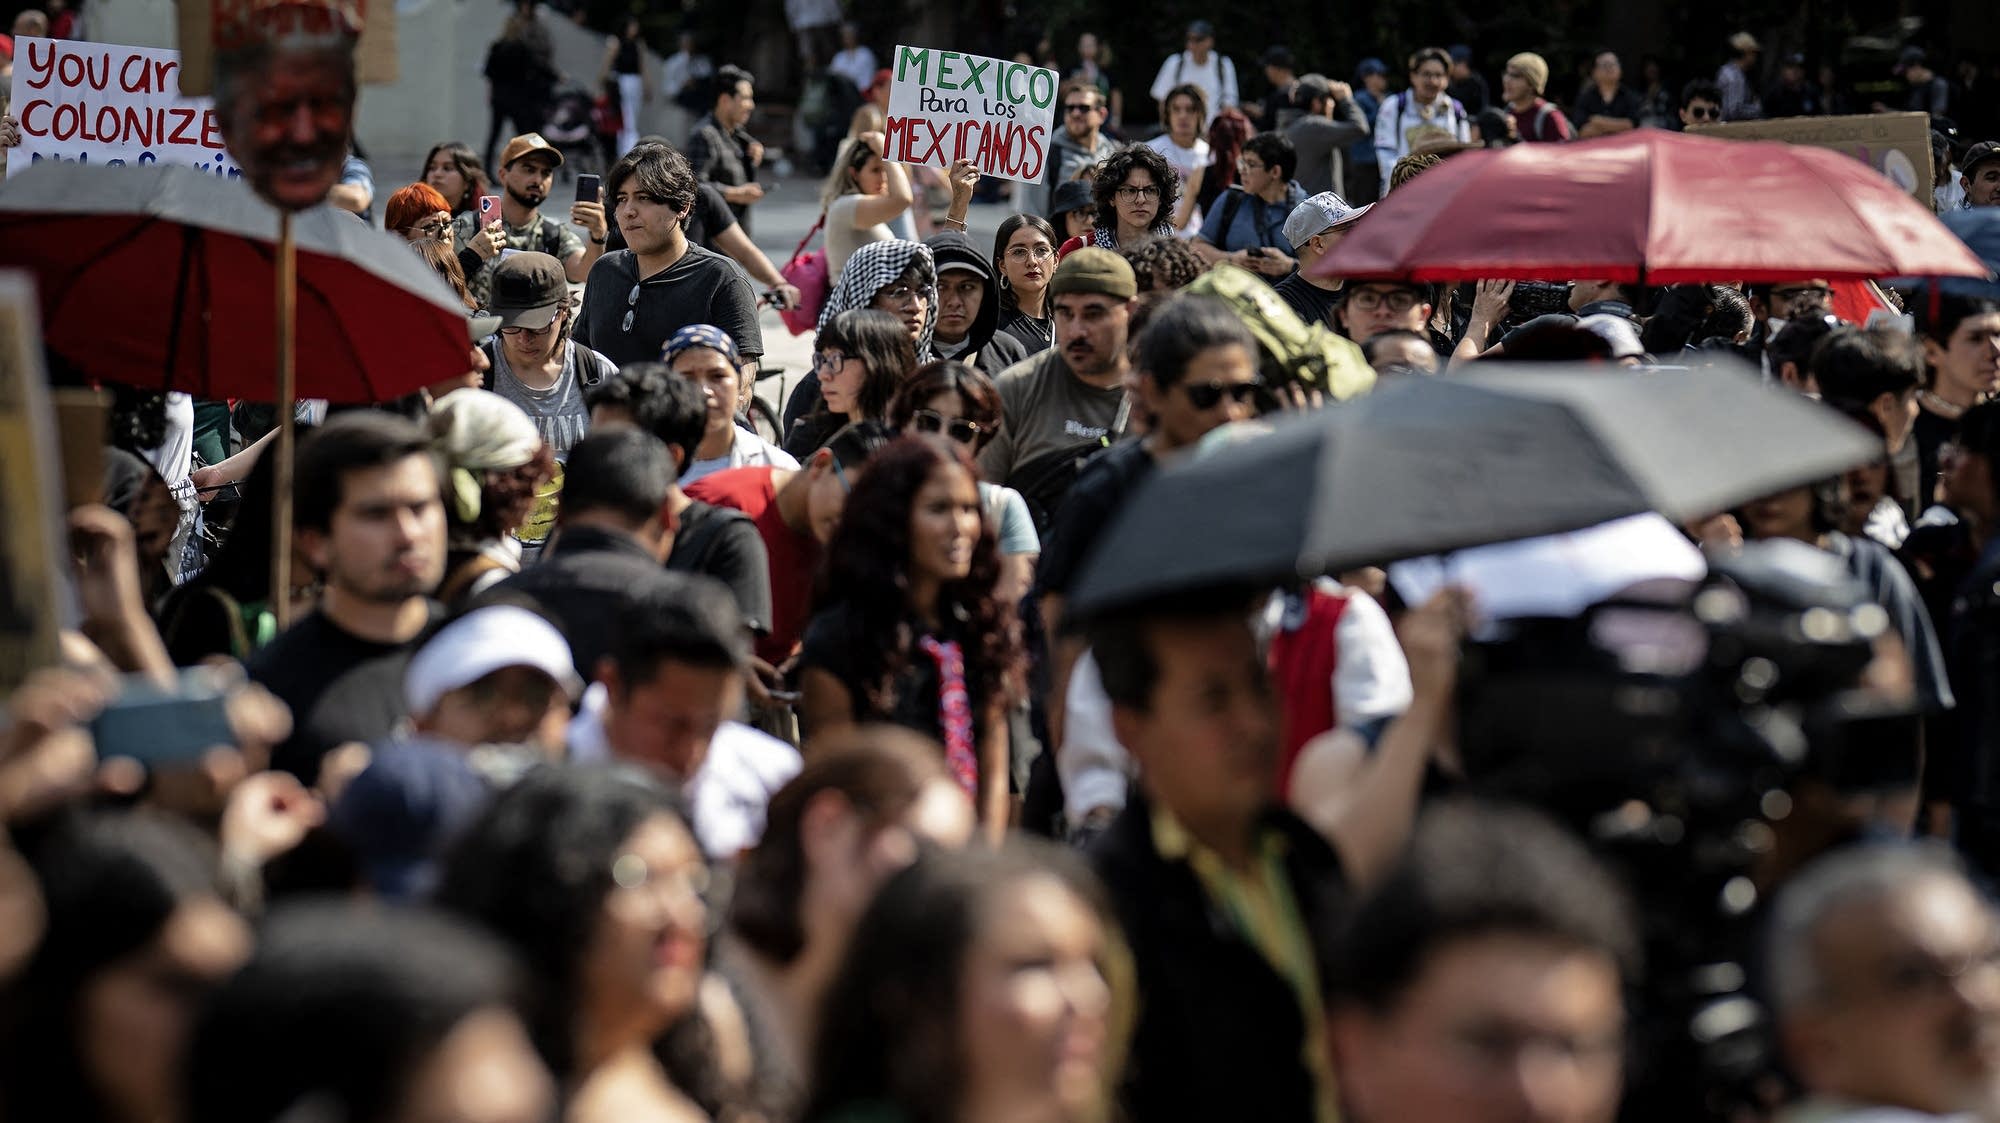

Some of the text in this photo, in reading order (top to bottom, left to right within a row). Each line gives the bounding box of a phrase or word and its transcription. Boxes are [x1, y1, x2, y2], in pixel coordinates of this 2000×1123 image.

[119, 54, 183, 94] ar
[897, 46, 1054, 109] MEXICO
[919, 87, 970, 114] Para
[882, 115, 1045, 180] MEXICANOS
